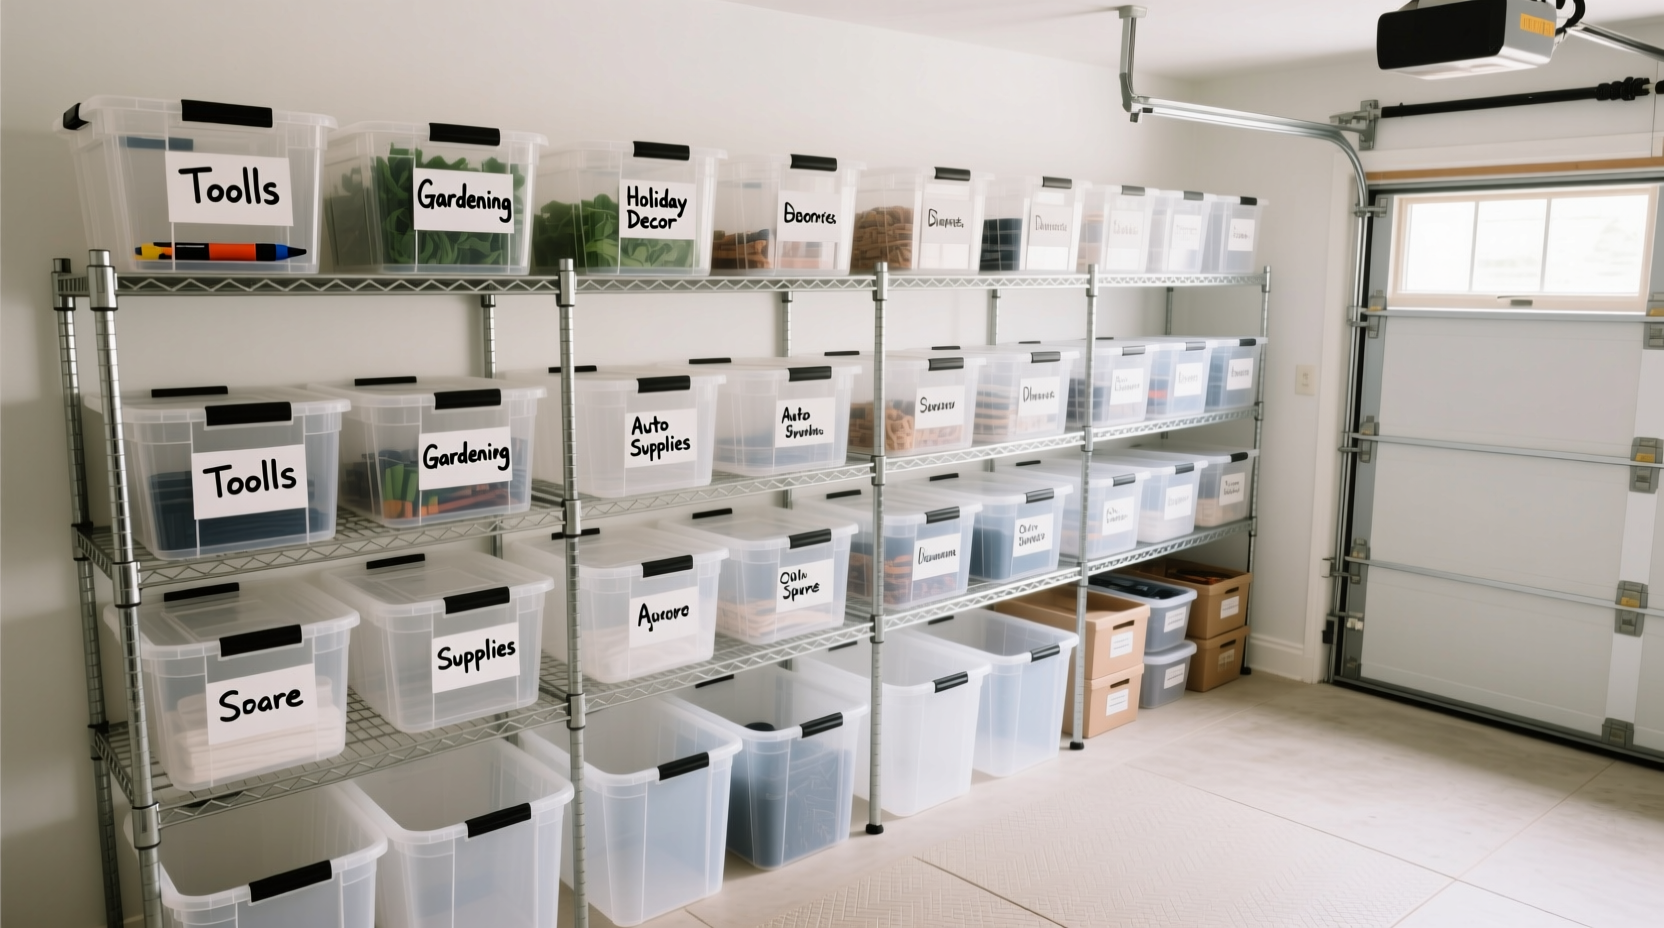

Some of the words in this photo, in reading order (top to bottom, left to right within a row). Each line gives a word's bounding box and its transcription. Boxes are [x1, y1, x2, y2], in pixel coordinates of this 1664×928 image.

[417, 178, 512, 224] Gardening
[626, 185, 688, 218] Holiday
[626, 209, 678, 230] Decor
[631, 415, 669, 436] Auto
[630, 435, 691, 462] Supplies
[437, 638, 516, 674] Supplies
[218, 688, 304, 723] Soare
